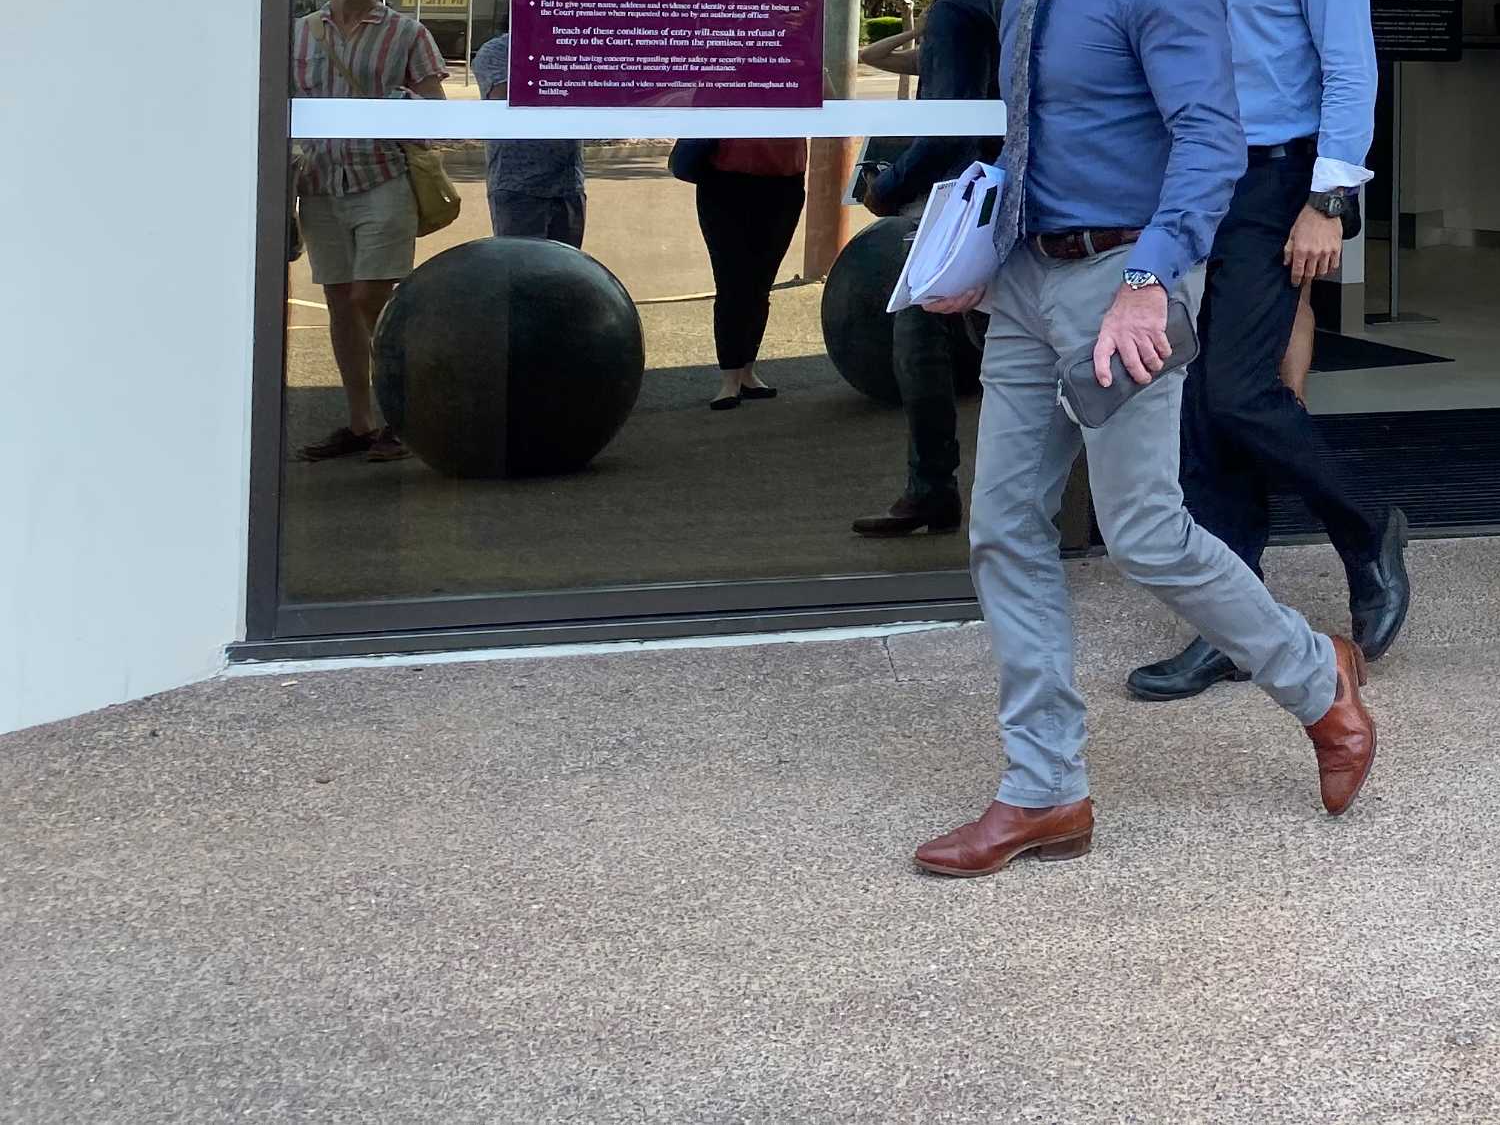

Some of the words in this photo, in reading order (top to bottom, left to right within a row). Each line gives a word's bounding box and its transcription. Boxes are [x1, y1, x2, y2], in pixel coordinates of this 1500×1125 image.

[552, 26, 580, 35] Breach
[583, 27, 592, 35] of
[593, 27, 614, 35] these
[617, 27, 658, 35] conditions
[694, 28, 709, 36] will
[748, 29, 775, 37] refusal
[777, 29, 786, 37] of
[556, 38, 578, 46] entry
[606, 37, 633, 46] Court,
[636, 38, 667, 46] removal
[669, 38, 689, 46] from
[706, 39, 743, 48] premises,
[756, 39, 782, 47] arrest.
